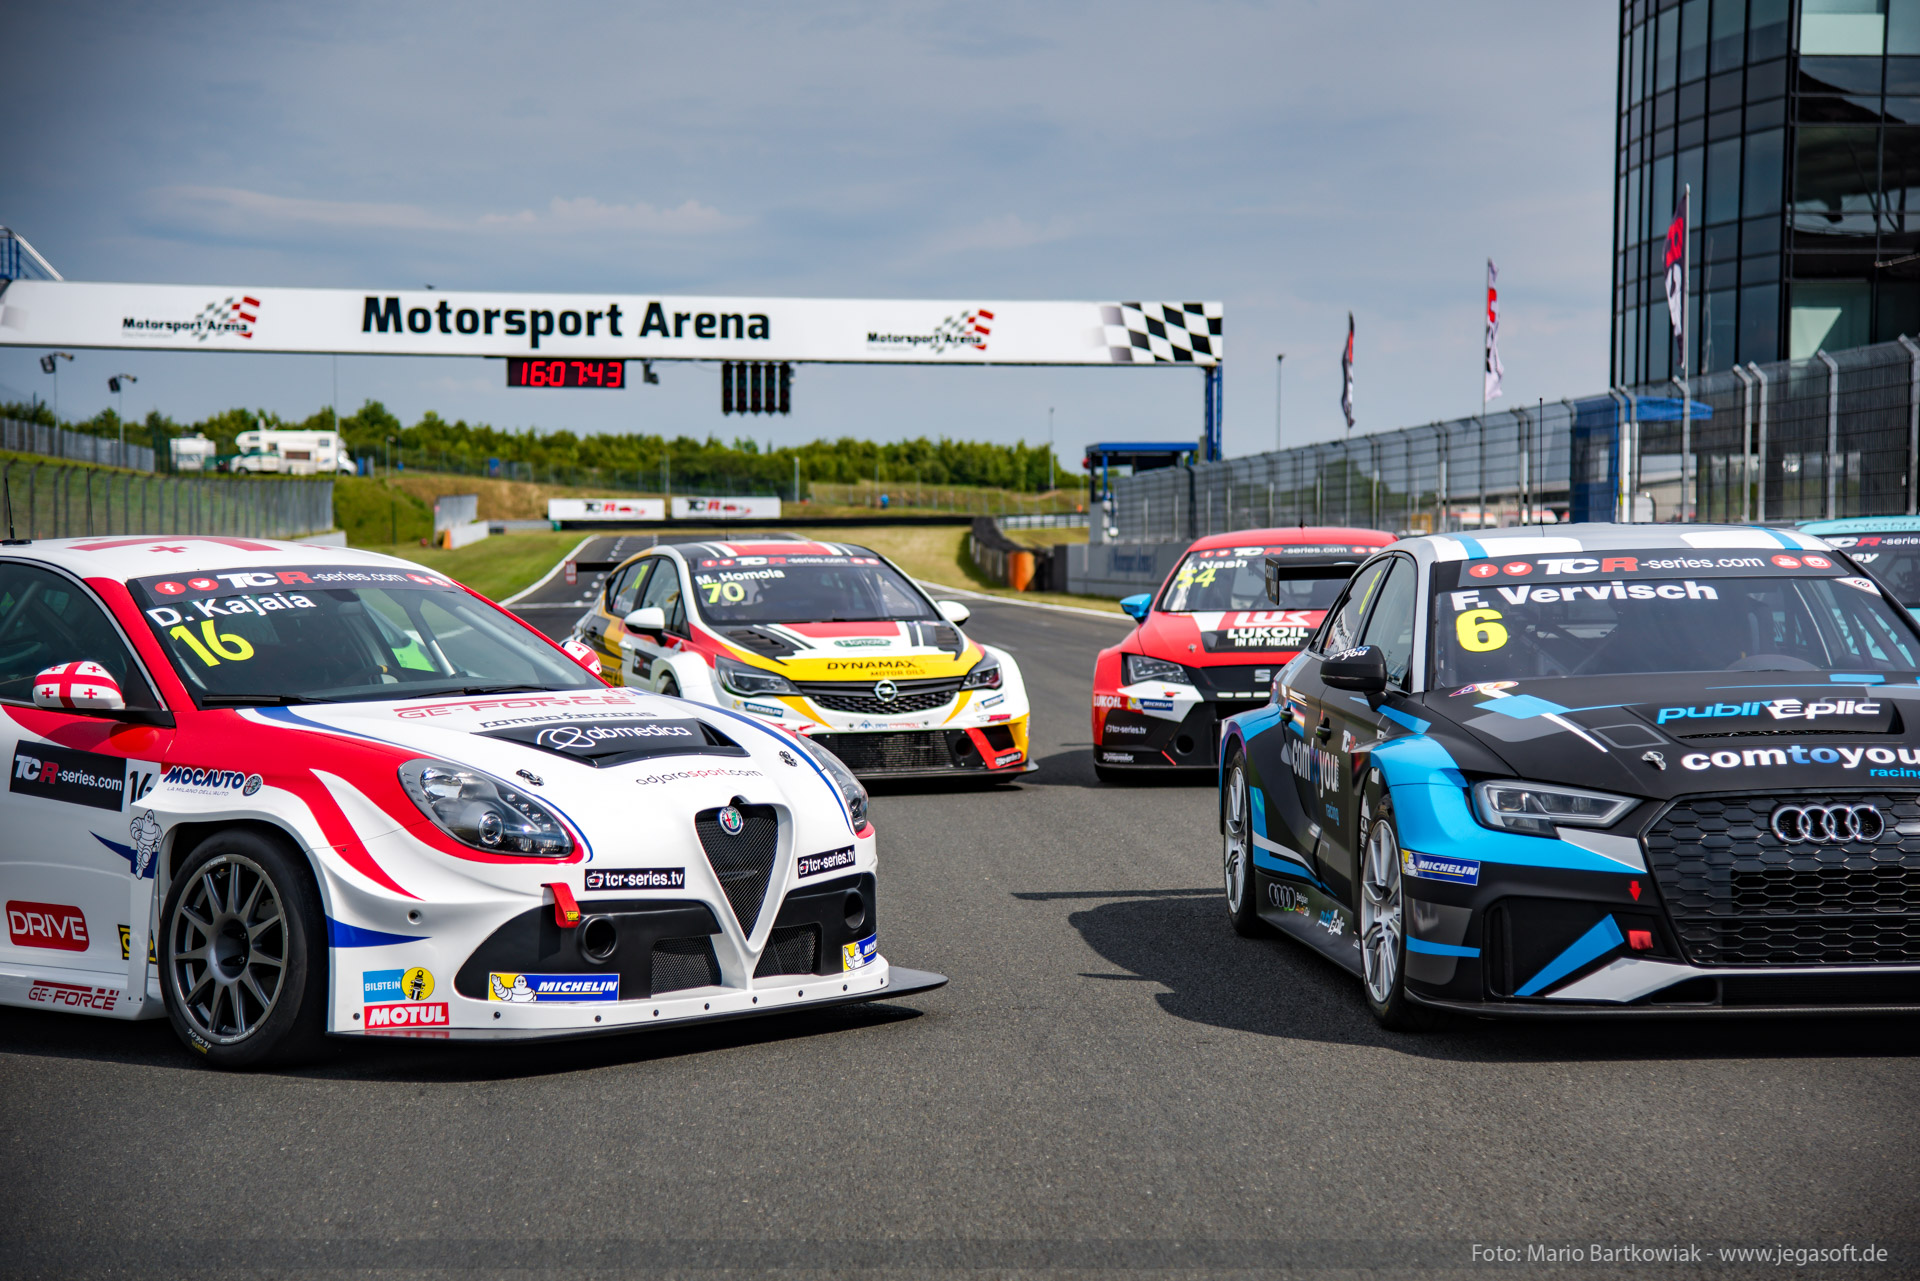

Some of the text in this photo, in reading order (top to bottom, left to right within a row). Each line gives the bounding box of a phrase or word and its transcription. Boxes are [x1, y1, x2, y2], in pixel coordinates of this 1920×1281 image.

[122, 318, 248, 333] Motorsport Arena
[362, 297, 770, 349] Motorsport Arena
[867, 332, 982, 346] Motorsport Arena
[1200, 559, 1248, 569] Nash
[1537, 555, 1765, 576] TCR-series.com
[217, 571, 408, 590] TCR-series.com
[695, 569, 785, 585] M. Homola
[1177, 568, 1217, 589] 54
[702, 582, 745, 604] 70
[1451, 580, 1719, 612] F. Vervisch
[146, 592, 317, 628] D. Kajaia
[1226, 627, 1309, 639] LUKOIL
[1455, 608, 1509, 653] 6
[169, 619, 255, 667] 16
[1234, 638, 1302, 647] IN MY HEART
[827, 661, 917, 670] DYNAMAX
[587, 723, 692, 740] abmedica
[1681, 745, 1920, 771] comtoyou
[15, 754, 123, 792] TCR-series.com
[163, 766, 245, 790] MOCAUTO
[635, 768, 764, 785] adjarasport.com
[1869, 767, 1920, 780] racin
[809, 848, 856, 872] tcr-series.tv
[1418, 860, 1479, 876] MICHELIN
[605, 870, 684, 887] tcr-series.tv
[9, 911, 88, 942] DRIVE
[364, 982, 401, 992] BILSTEIN
[538, 981, 618, 992] MICHELIN
[28, 986, 120, 1011] GE-FORCE
[368, 1005, 447, 1027] MOTUL
